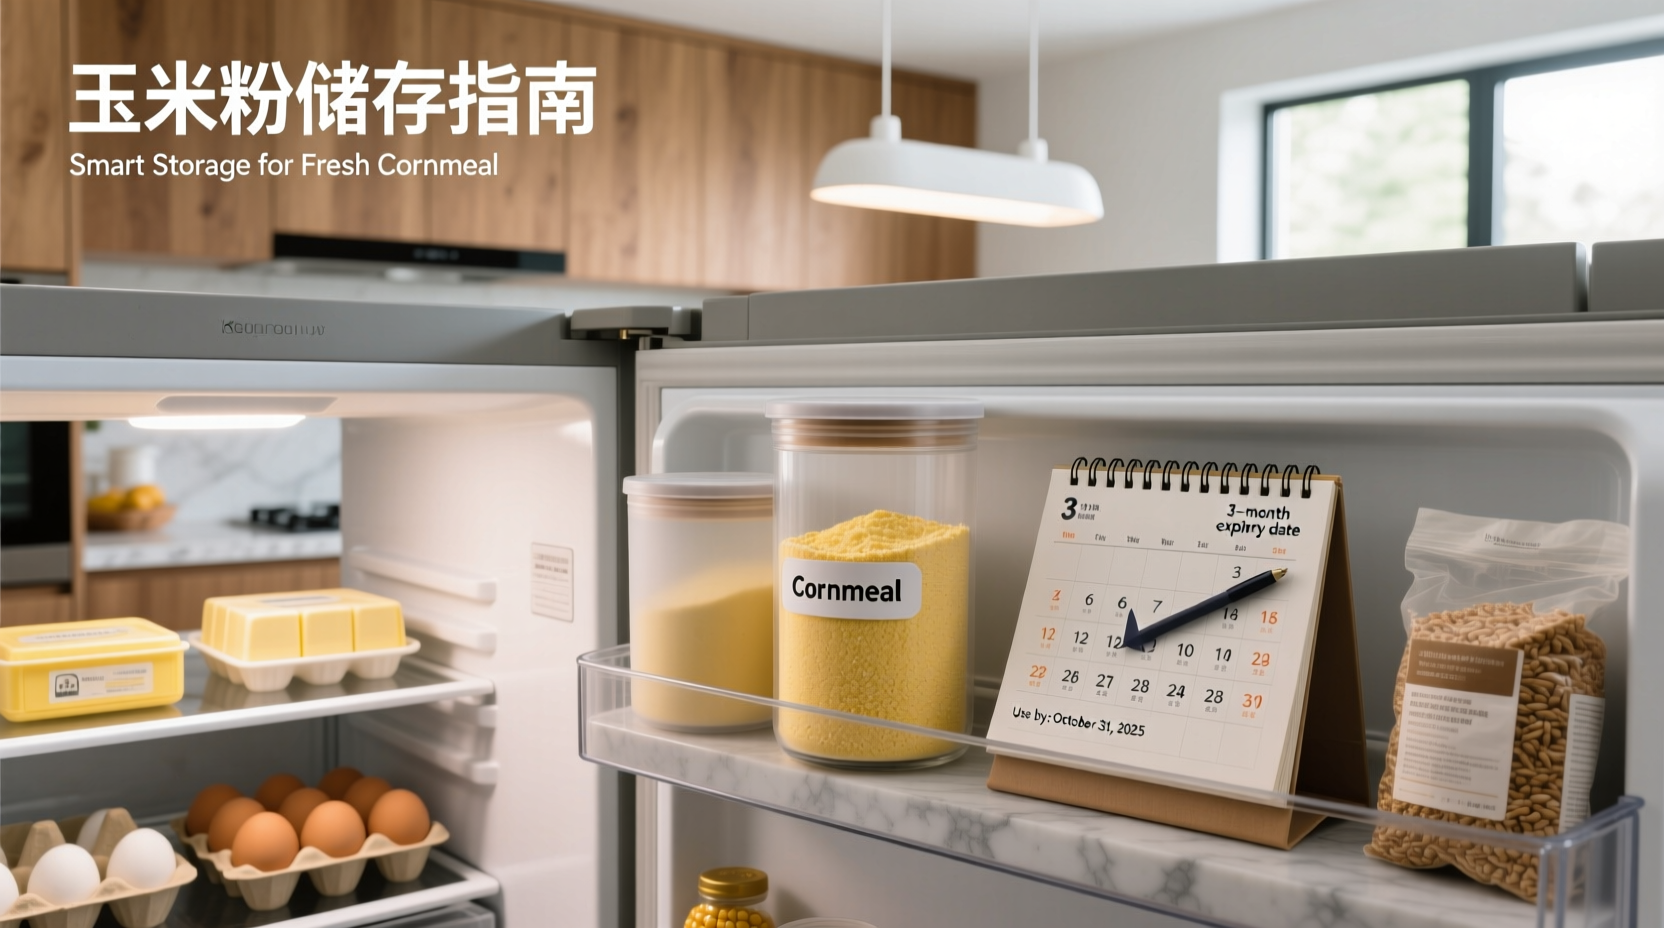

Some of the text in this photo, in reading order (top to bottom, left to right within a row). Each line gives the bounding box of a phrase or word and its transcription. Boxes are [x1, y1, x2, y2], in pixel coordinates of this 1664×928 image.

[1061, 497, 1078, 520] 3
[1227, 504, 1290, 520] 3-month
[1269, 522, 1300, 537] date
[1232, 566, 1242, 579] 3
[792, 574, 901, 602] Cornmeal
[1085, 593, 1094, 606] 6
[1117, 596, 1127, 609] 6
[1153, 600, 1163, 613] 7
[1041, 626, 1056, 641] 12
[1074, 630, 1089, 645] 12
[1177, 643, 1195, 658] 10
[1061, 669, 1080, 684] 26
[1095, 673, 1114, 689] 27
[1130, 678, 1150, 693] 28
[1203, 688, 1224, 704] 28
[1012, 706, 1146, 737] Use by: October 31, 2025
